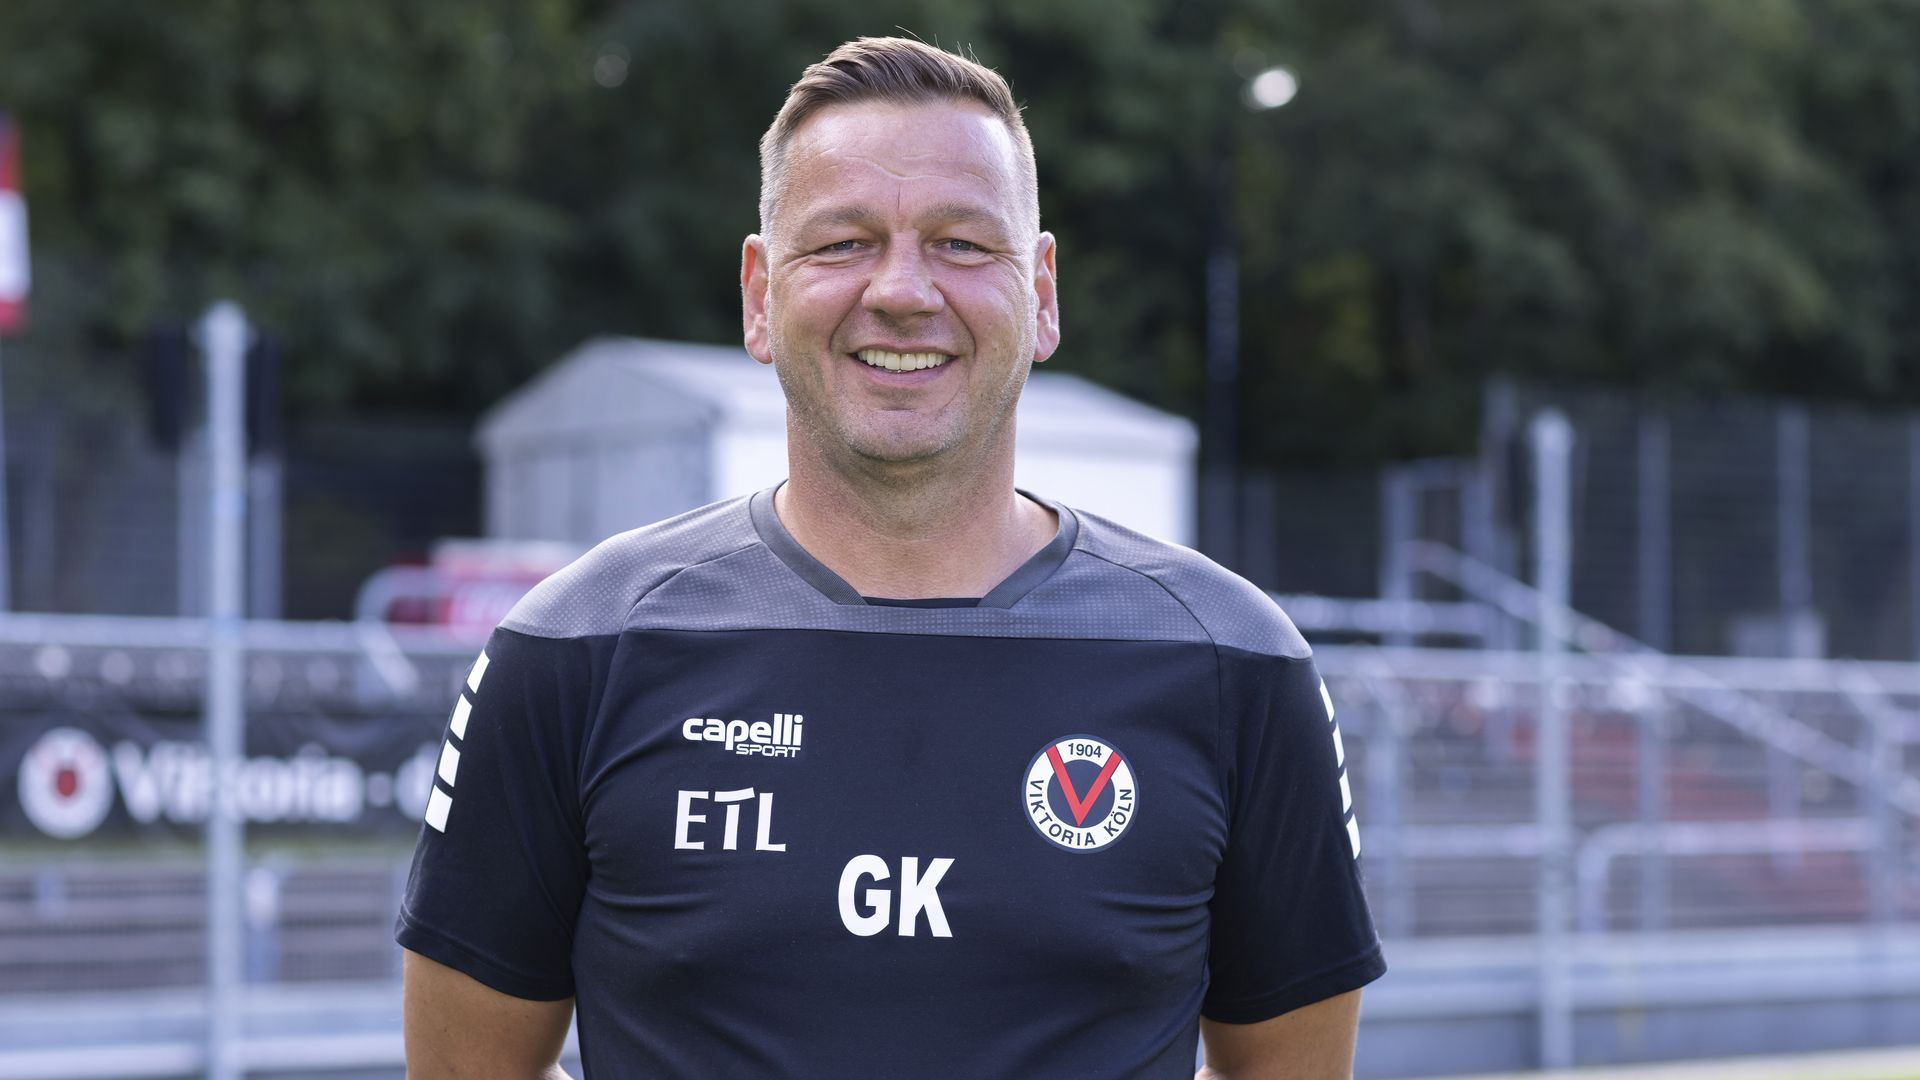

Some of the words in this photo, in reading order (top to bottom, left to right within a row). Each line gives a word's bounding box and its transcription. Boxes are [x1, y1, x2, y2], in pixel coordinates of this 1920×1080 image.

[682, 713, 803, 750] capelli
[735, 744, 801, 758] SPORT
[1068, 743, 1102, 758] 1904
[113, 741, 363, 824] Vikoria
[1029, 779, 1096, 846] VIKTORIA
[1103, 788, 1132, 837] KÖLN
[674, 787, 786, 852] ETL
[838, 854, 955, 937] GK
